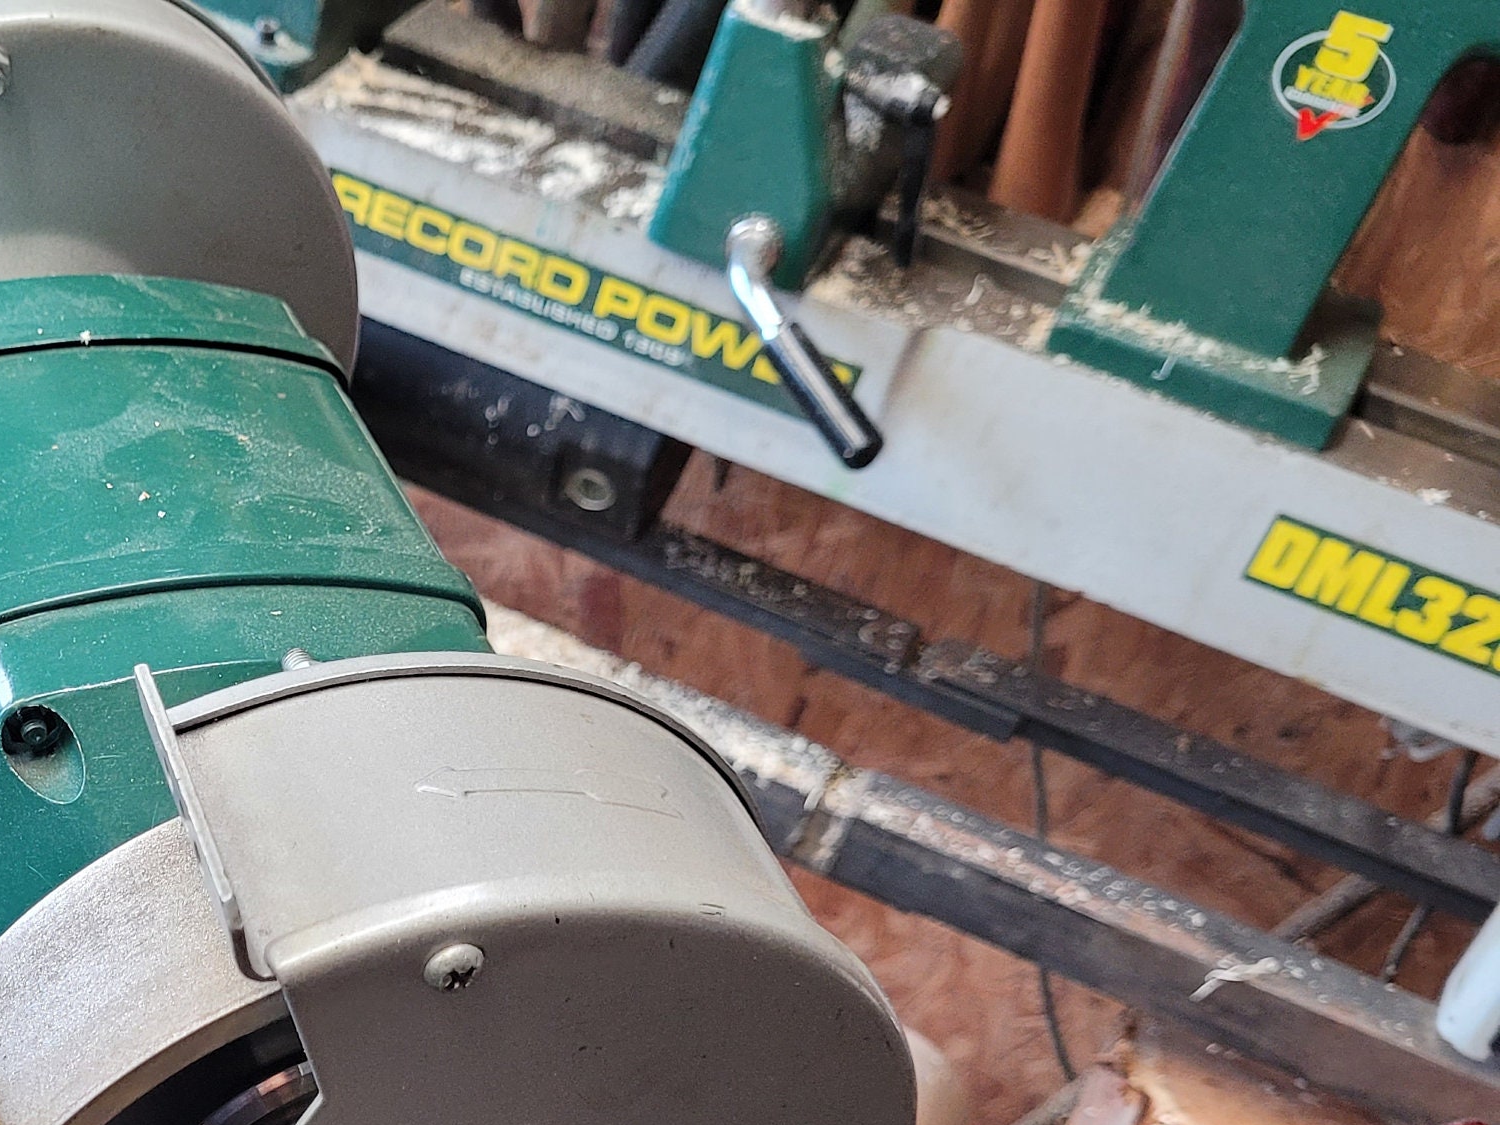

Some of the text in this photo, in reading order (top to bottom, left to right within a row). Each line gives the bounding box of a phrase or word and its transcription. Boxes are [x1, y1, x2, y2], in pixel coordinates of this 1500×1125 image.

[1314, 10, 1394, 82] 5
[1293, 64, 1371, 108] YEAR
[332, 173, 589, 306] RECORD
[457, 268, 619, 342] ESTABLISHED
